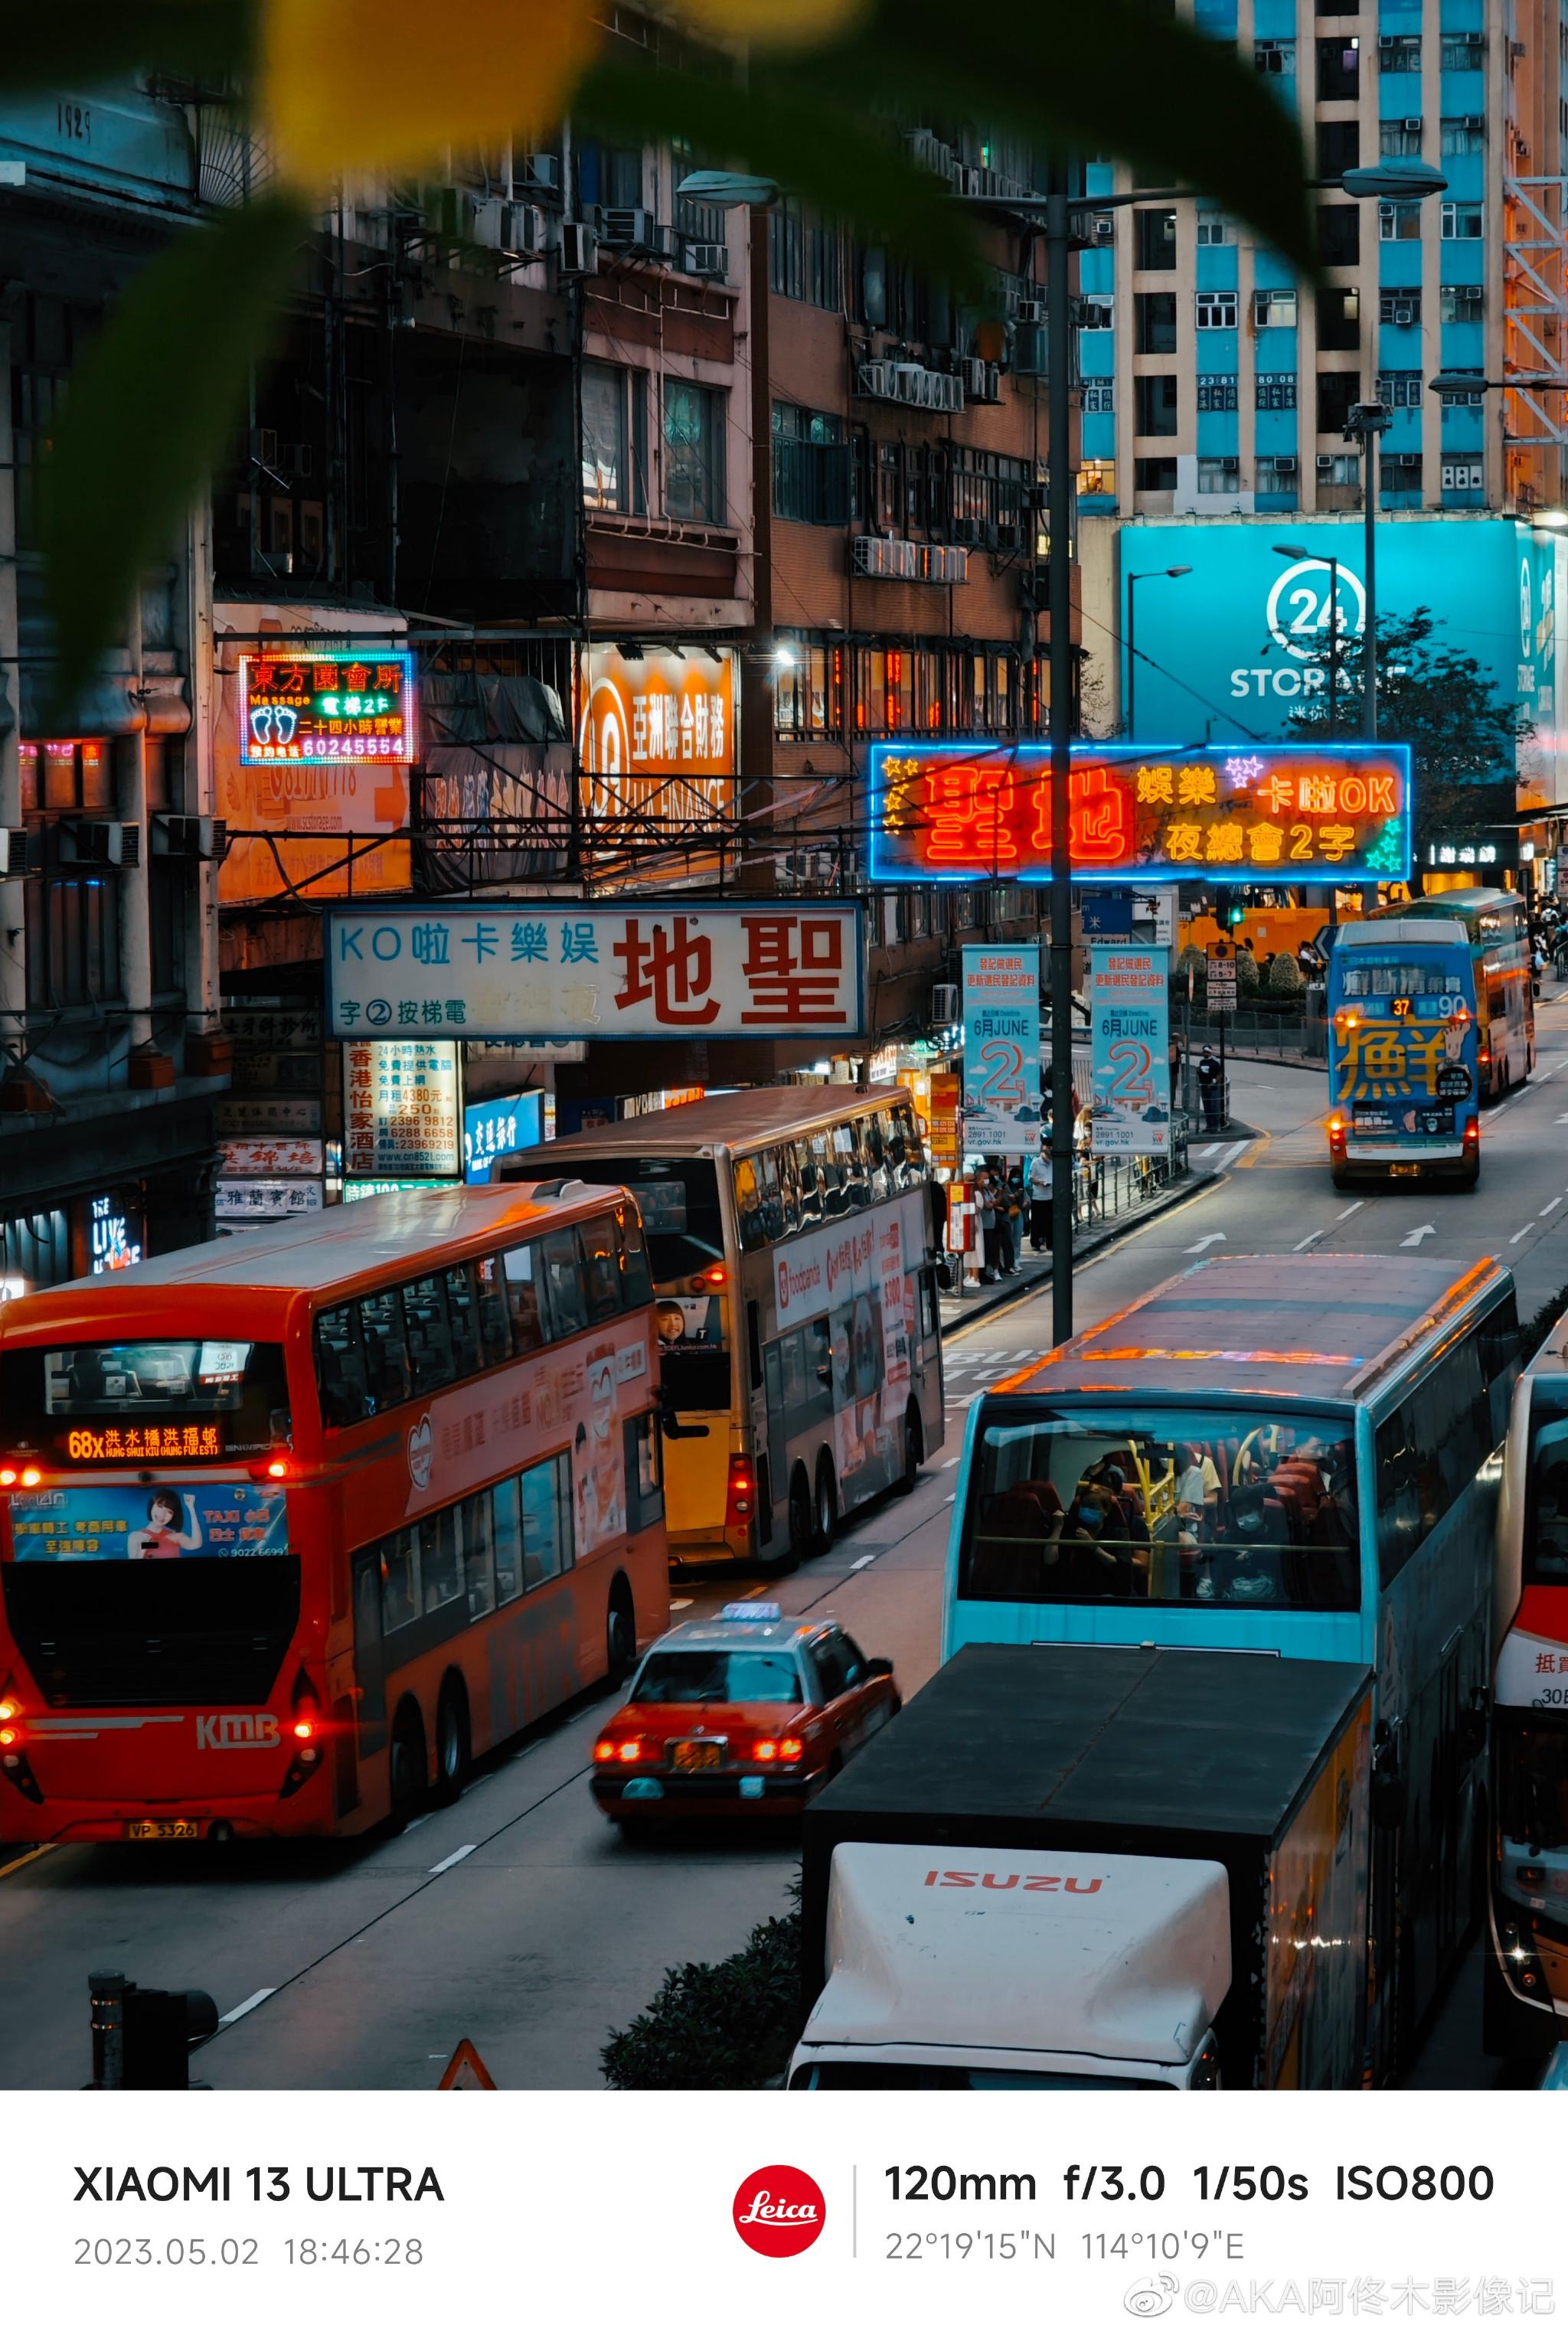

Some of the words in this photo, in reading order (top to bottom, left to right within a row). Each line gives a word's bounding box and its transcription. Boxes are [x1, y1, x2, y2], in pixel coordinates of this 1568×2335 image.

[57, 101, 91, 144] 1929
[1289, 588, 1348, 634] 24
[250, 661, 403, 694] 東方園會所
[1230, 666, 1406, 697] STORAE
[250, 694, 311, 707] Massage
[299, 718, 403, 736] 二十四小時營業
[632, 692, 724, 760] 亞洲聯合財務
[302, 738, 403, 756] 60245554
[925, 764, 1125, 861] 聖地
[1256, 775, 1396, 815] 卡啦OK
[1166, 823, 1356, 862] 夜總會2字
[1394, 999, 1410, 1016] 37
[1439, 995, 1468, 1019] 90
[349, 1050, 374, 1171] 香港怡家酒店
[398, 1104, 432, 1115] 250
[390, 1117, 420, 1126] 2396
[424, 1116, 453, 1126] 9812
[391, 1128, 420, 1138] 6288
[424, 1128, 453, 1138] 6658
[968, 1130, 987, 1139] 2891
[989, 1130, 1007, 1138] 1001
[1096, 1130, 1116, 1139] 2891
[1118, 1130, 1135, 1138] 1001
[968, 1138, 1001, 1147] vr.gov.hk
[1096, 1138, 1130, 1147] vr.gov.hk
[92, 1197, 109, 1218] THE
[227, 1190, 305, 1207] 雅蘭賓館
[106, 1427, 217, 1448] 洪水橋洪福邨
[106, 1447, 125, 1458] HUNG
[126, 1447, 144, 1457] SHUI
[145, 1446, 159, 1457] KIU
[160, 1446, 182, 1456] (HUNG
[184, 1445, 198, 1455] FUK
[198, 1445, 218, 1455] EST)
[203, 1510, 240, 1523] TAXI
[230, 1548, 257, 1557] 9022
[196, 1714, 281, 1750] KMB
[132, 1824, 152, 1837] VP
[157, 1824, 194, 1837] 5326
[924, 1870, 1102, 1894] ISUZU
